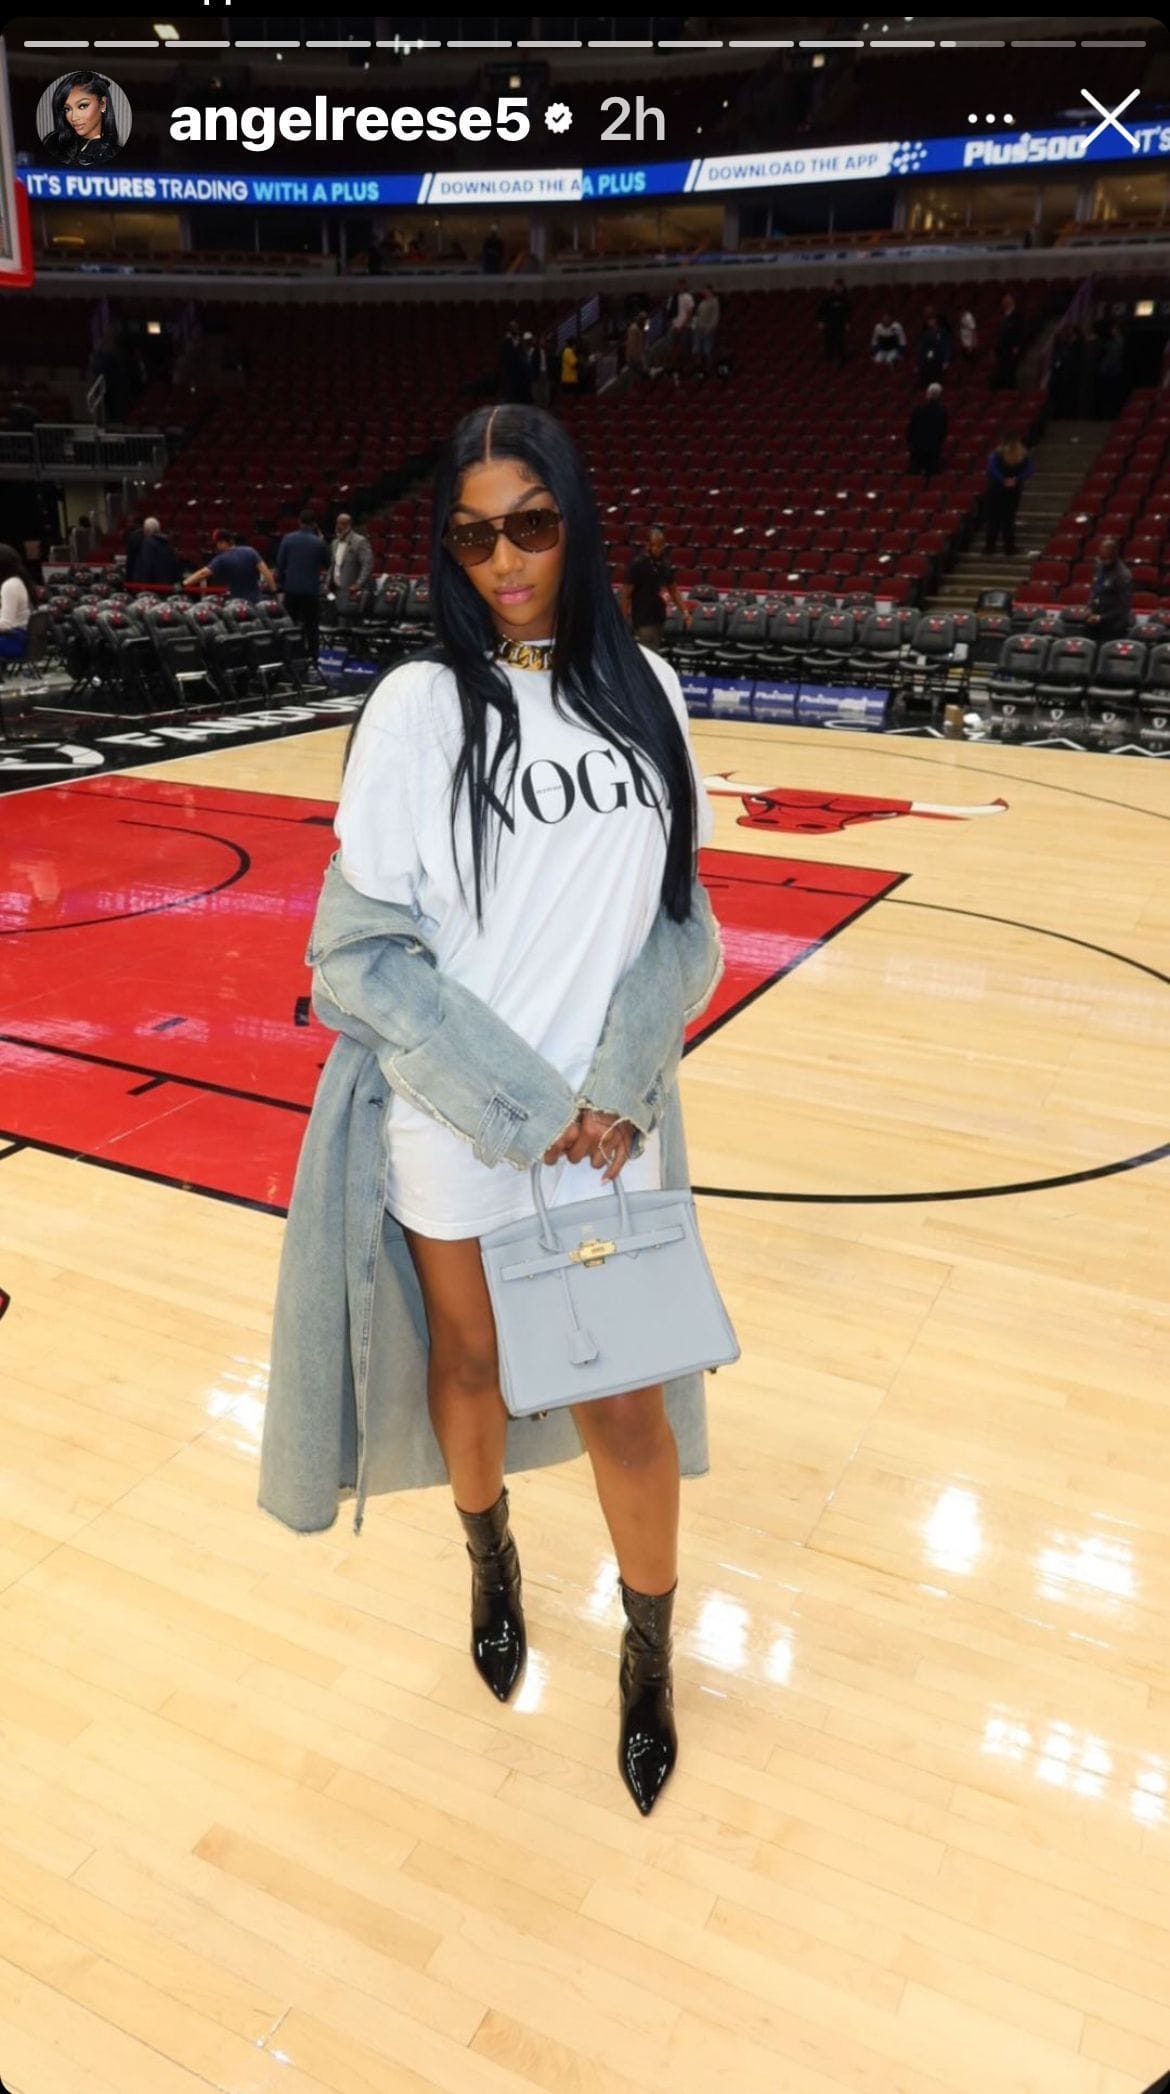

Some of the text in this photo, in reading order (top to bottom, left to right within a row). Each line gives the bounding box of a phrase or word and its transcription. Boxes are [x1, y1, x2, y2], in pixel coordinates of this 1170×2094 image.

[963, 132, 1089, 167] Plus500
[708, 153, 879, 181] DOWNLOAD THE APP
[26, 174, 379, 202] IT'S FUTURES TRADING WITH A PLUS
[440, 180, 533, 195] DOWNLOAD
[538, 178, 565, 192] THE
[582, 171, 647, 195] A PLUS
[474, 748, 673, 835] VOGU
